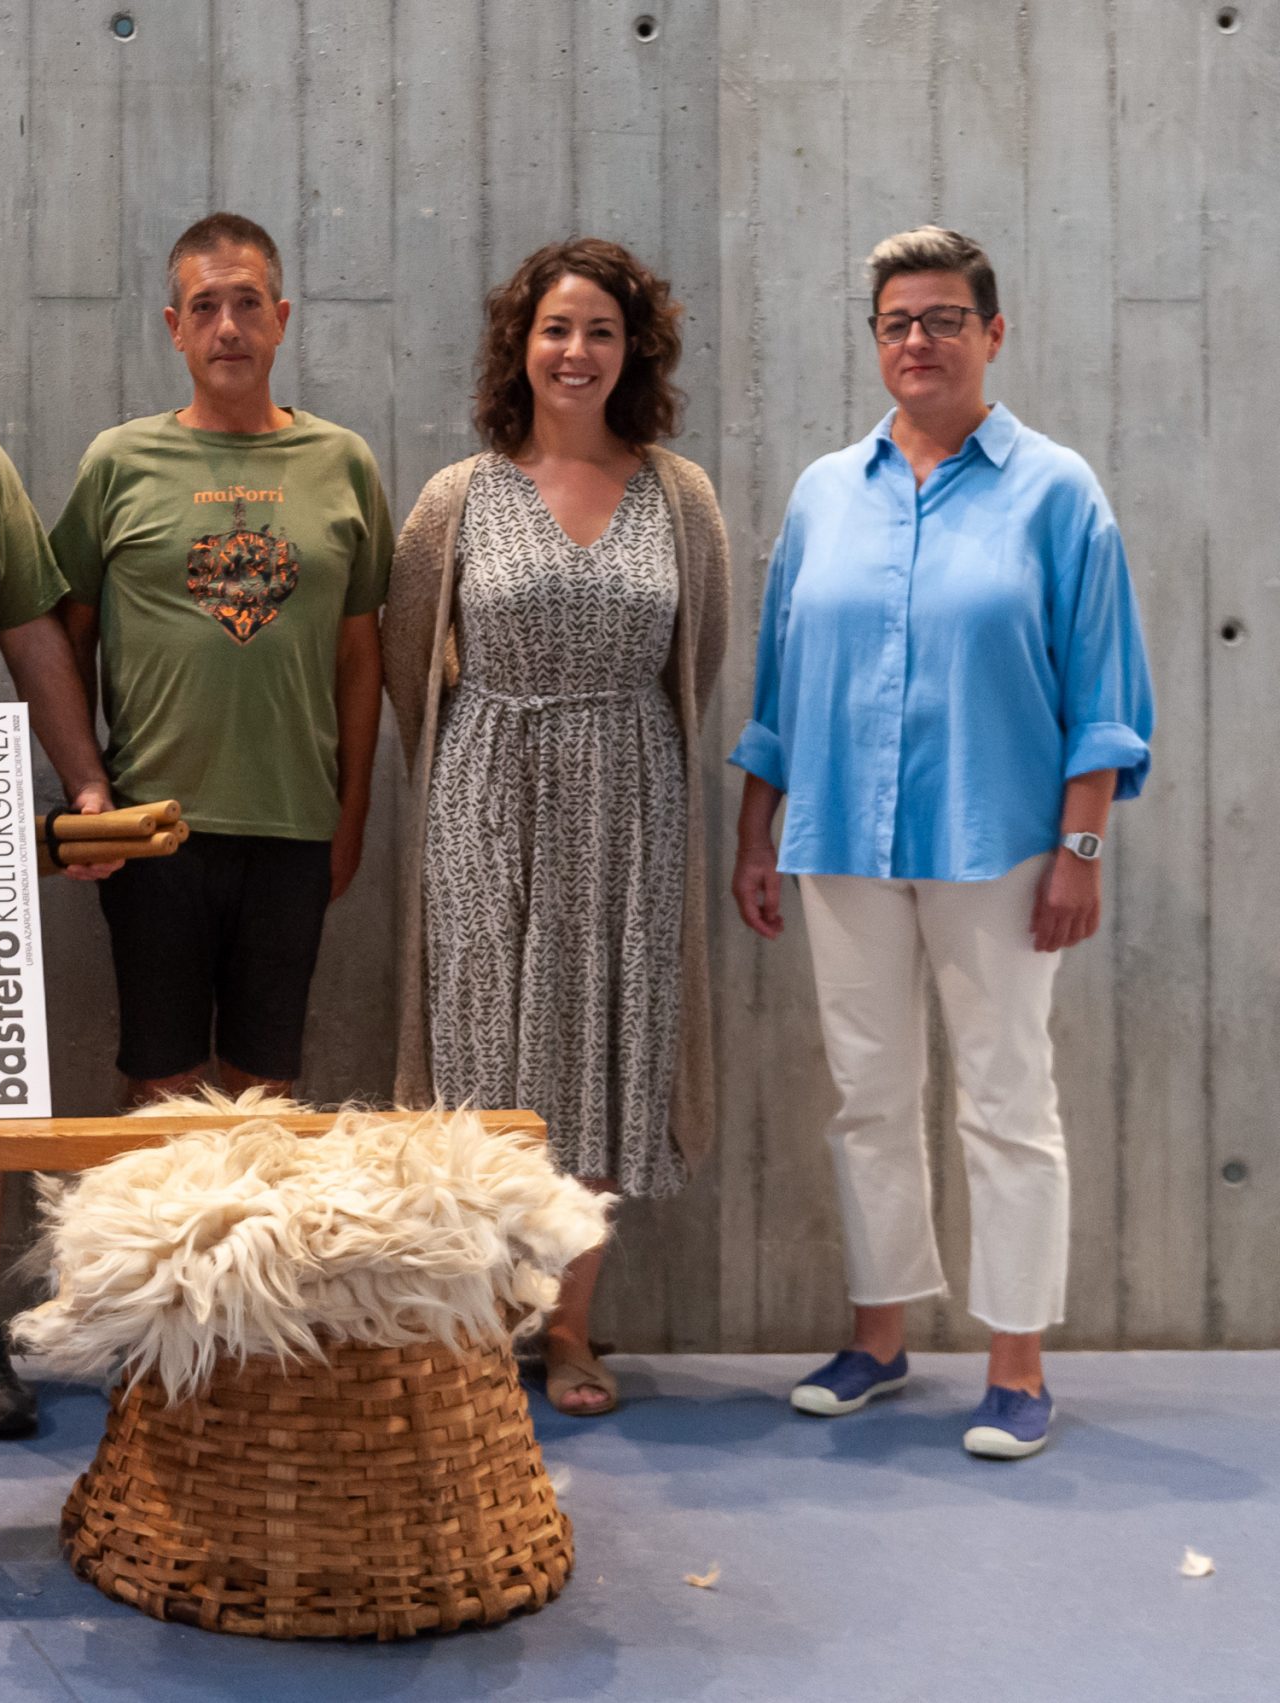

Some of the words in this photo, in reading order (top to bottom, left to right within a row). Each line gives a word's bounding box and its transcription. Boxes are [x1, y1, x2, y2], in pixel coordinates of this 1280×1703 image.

[12, 715, 20, 732] 2022
[13, 736, 23, 777] DICIEMBRE
[15, 780, 25, 823] NOVIEMBRE
[18, 825, 28, 862] OCTUBRE
[20, 869, 30, 906] ABENDUA
[22, 908, 32, 940] AZAROA
[24, 942, 34, 966] URRIA
